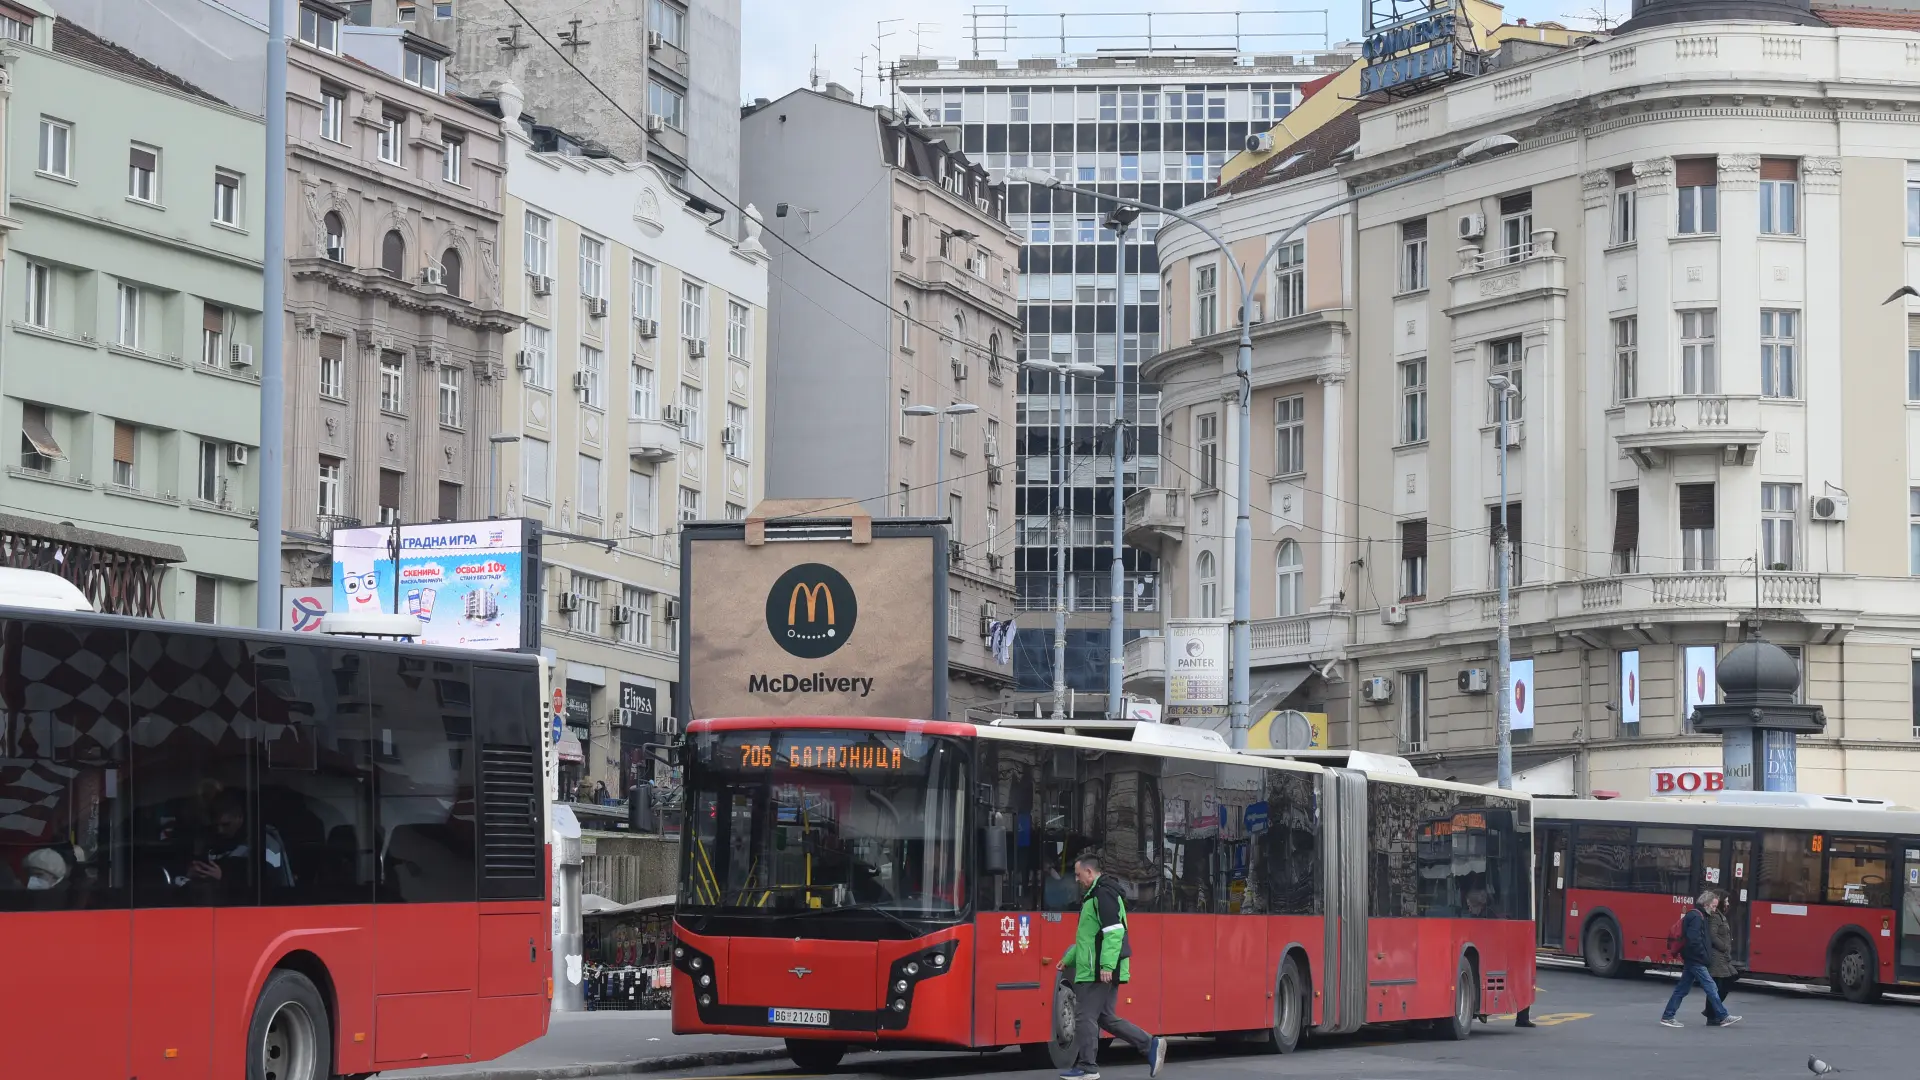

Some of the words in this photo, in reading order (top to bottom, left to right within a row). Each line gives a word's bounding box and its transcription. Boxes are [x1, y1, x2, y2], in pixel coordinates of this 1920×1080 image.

[1361, 46, 1448, 92] SYSTEM
[449, 535, 477, 546] ИГРА
[403, 568, 440, 577] СКЕНИРАЈ
[455, 566, 485, 574] ОСВОЈИ
[1178, 658, 1214, 667] PANTER
[749, 672, 874, 697] McDelivery
[624, 687, 652, 715] Elipsa
[1182, 706, 1198, 714] 245
[1201, 706, 1212, 714] 99
[1216, 706, 1226, 714] 77
[741, 745, 771, 767] 706
[790, 745, 901, 769] БАТАЈНИЦА
[1812, 835, 1822, 852] 68
[1001, 939, 1014, 954] 894
[775, 1010, 786, 1021] BG
